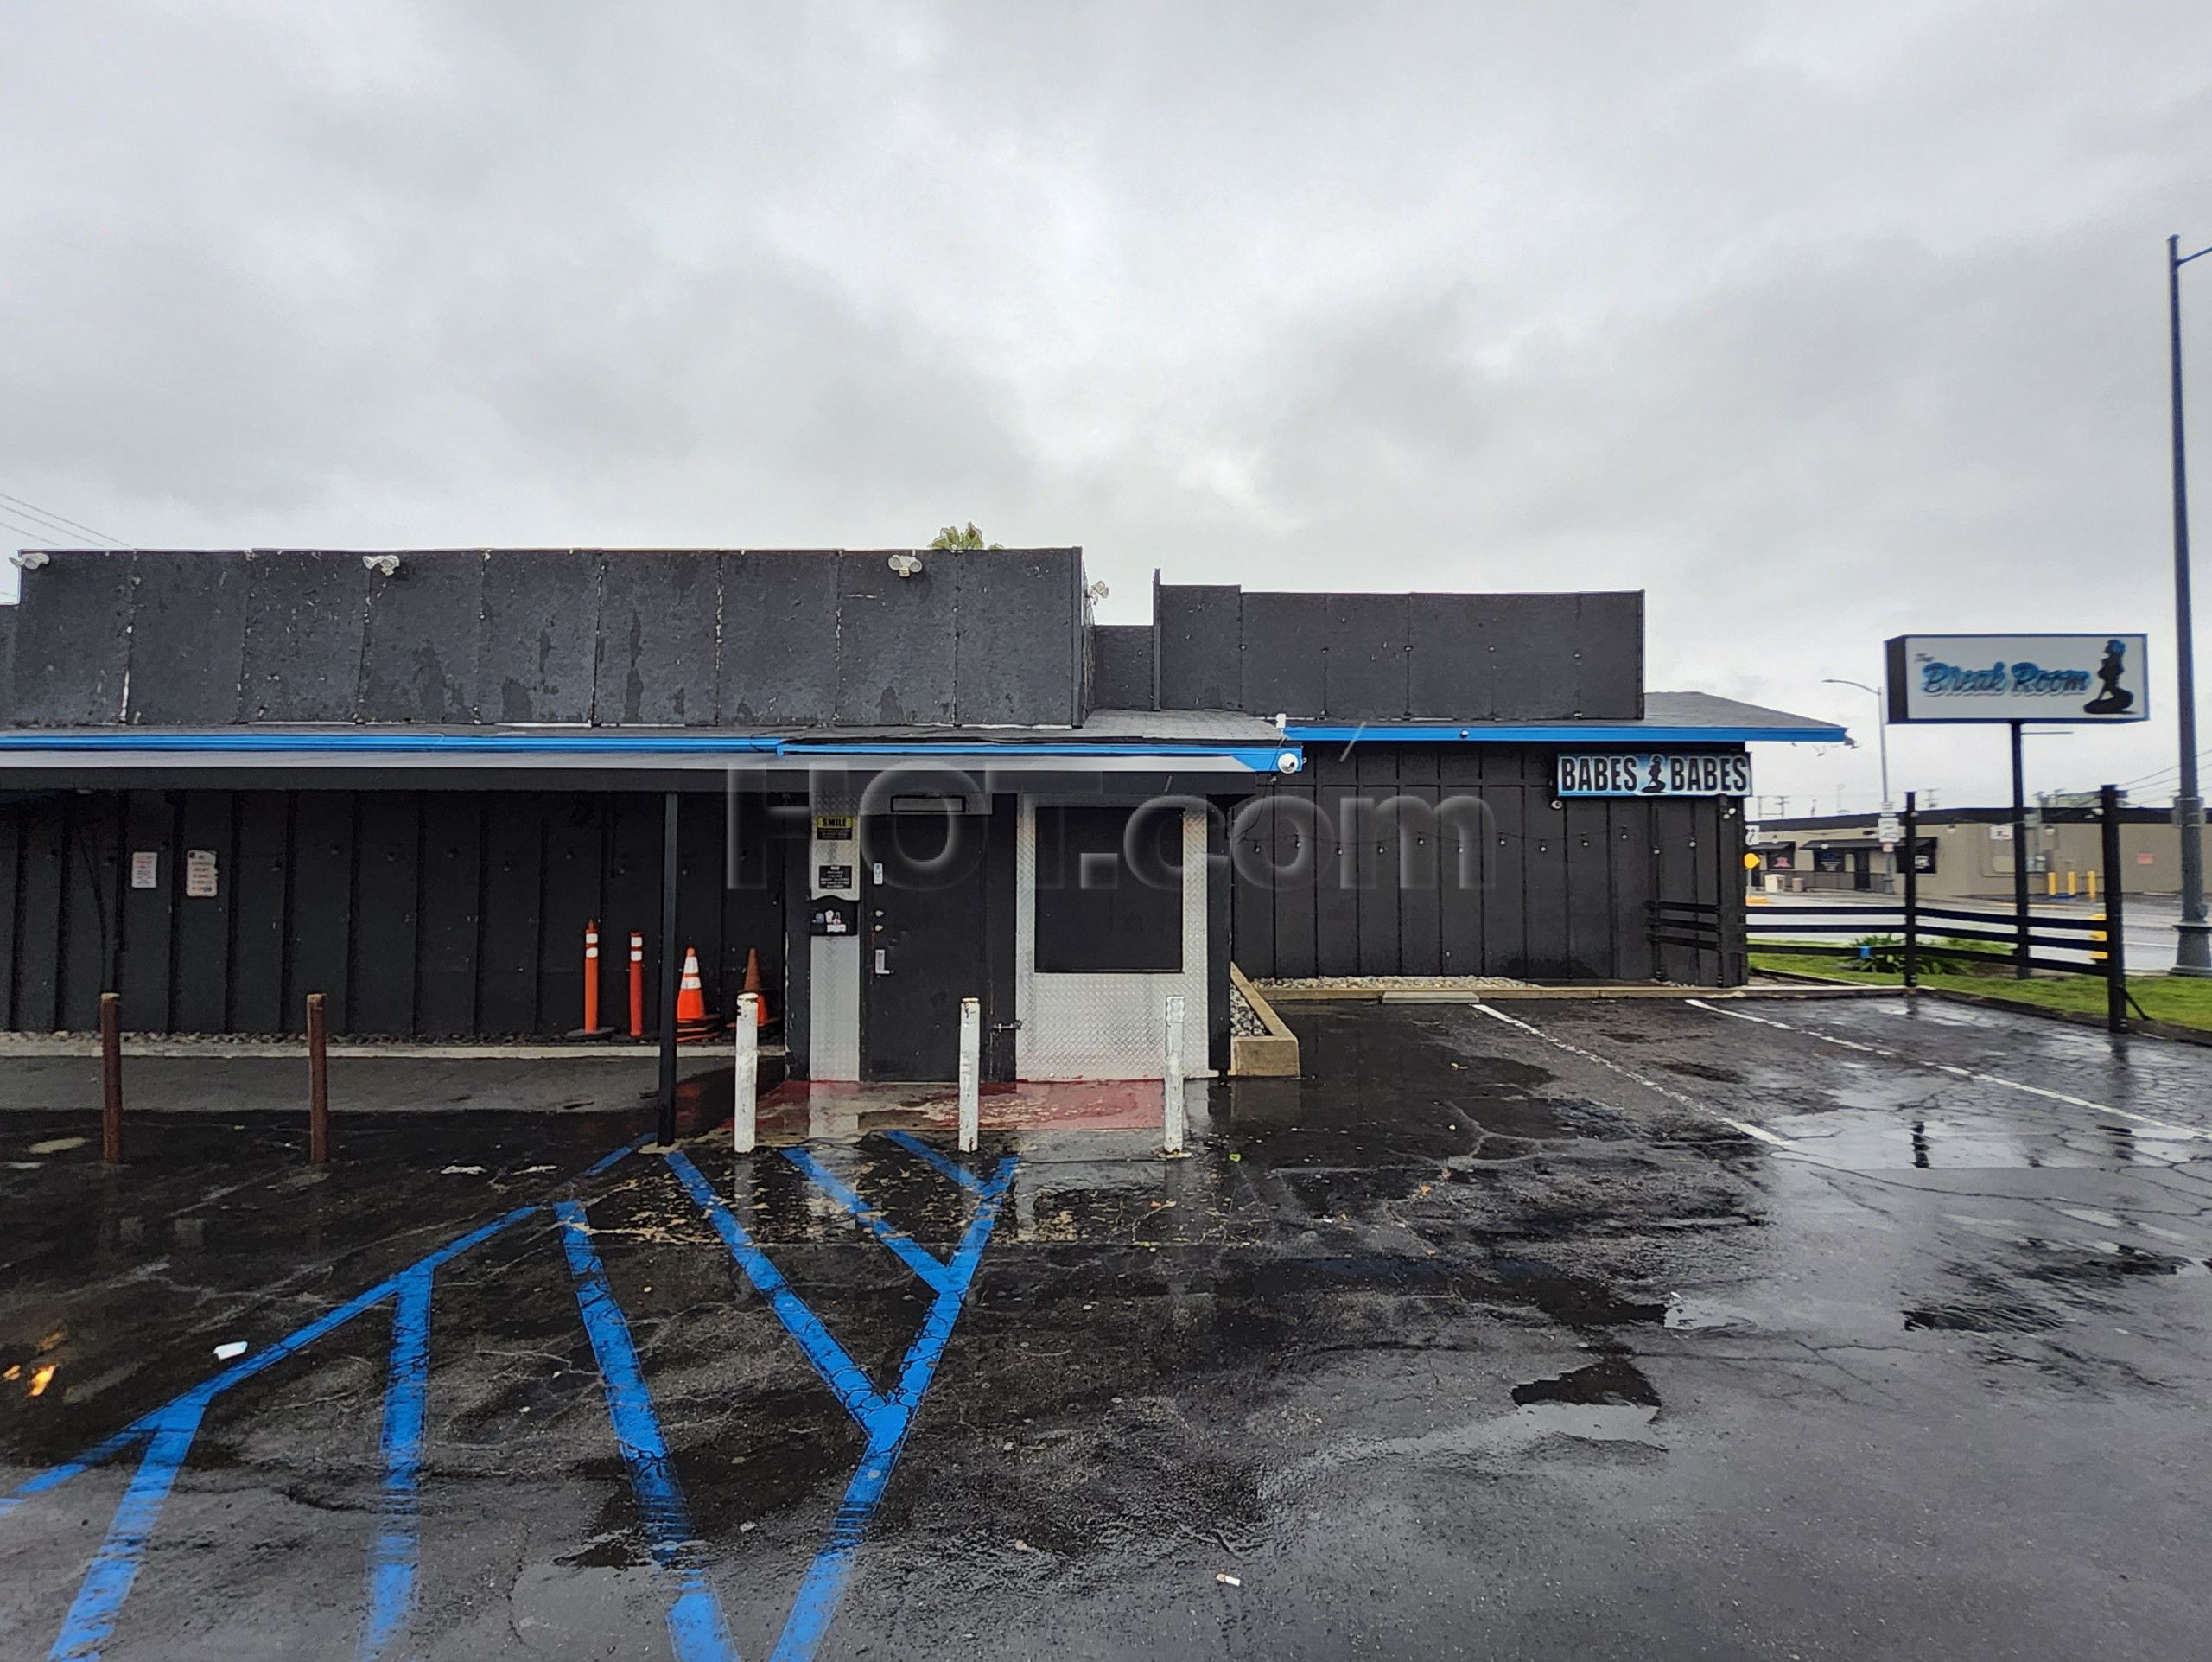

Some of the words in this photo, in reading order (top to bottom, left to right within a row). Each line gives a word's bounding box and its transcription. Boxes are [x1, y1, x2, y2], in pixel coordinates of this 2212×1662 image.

[1922, 661, 2006, 695] Break
[2010, 661, 2092, 695] Room
[1561, 757, 1637, 792] BABES
[1670, 757, 1747, 792] BABES
[822, 818, 847, 827] SMILE
